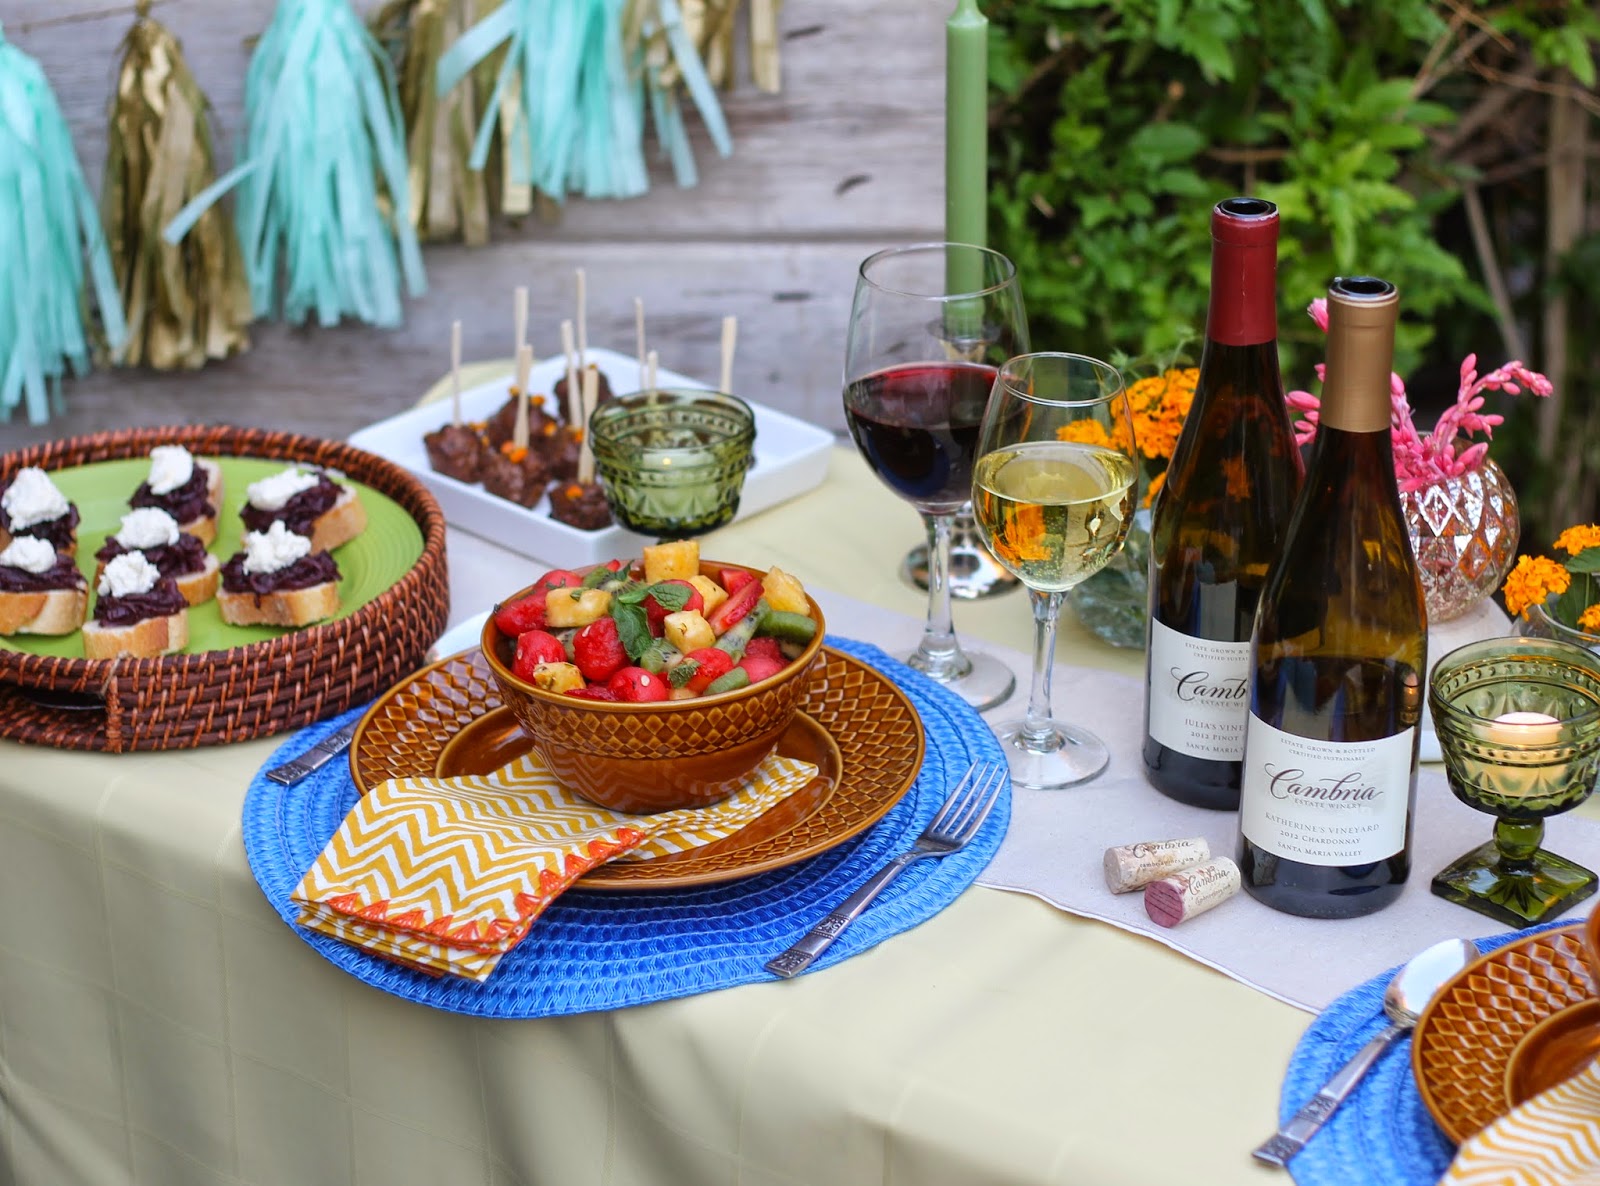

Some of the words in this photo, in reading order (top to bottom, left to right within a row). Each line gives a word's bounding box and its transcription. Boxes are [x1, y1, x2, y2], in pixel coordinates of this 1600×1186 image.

[1185, 642, 1207, 652] ESTATE
[1210, 646, 1236, 654] GROWN
[1193, 652, 1225, 661] CERTIFIED
[1170, 667, 1248, 702] Camb
[1200, 700, 1229, 708] ESTATE
[1185, 718, 1217, 730] JULIA'S
[1219, 724, 1244, 732] VINE
[1190, 731, 1209, 740] 2012
[1186, 742, 1210, 752] SANTA
[1280, 738, 1304, 749] ESTATE
[1306, 745, 1333, 753] GROWN
[1288, 749, 1321, 760] CERTIFIED
[1264, 762, 1384, 801] Cambria
[1294, 799, 1325, 809] ESTATE
[1328, 802, 1362, 810] WINERY
[1265, 812, 1326, 834] KATHERINE'S
[1328, 823, 1380, 835] VINEYARD
[1280, 829, 1298, 840] 2012
[1301, 835, 1361, 845] CHARDONNAY
[1277, 841, 1302, 853] SANTA
[1304, 848, 1332, 857] MARIA
[1334, 849, 1362, 857] VALLEY
[1188, 865, 1230, 896] Cambria
